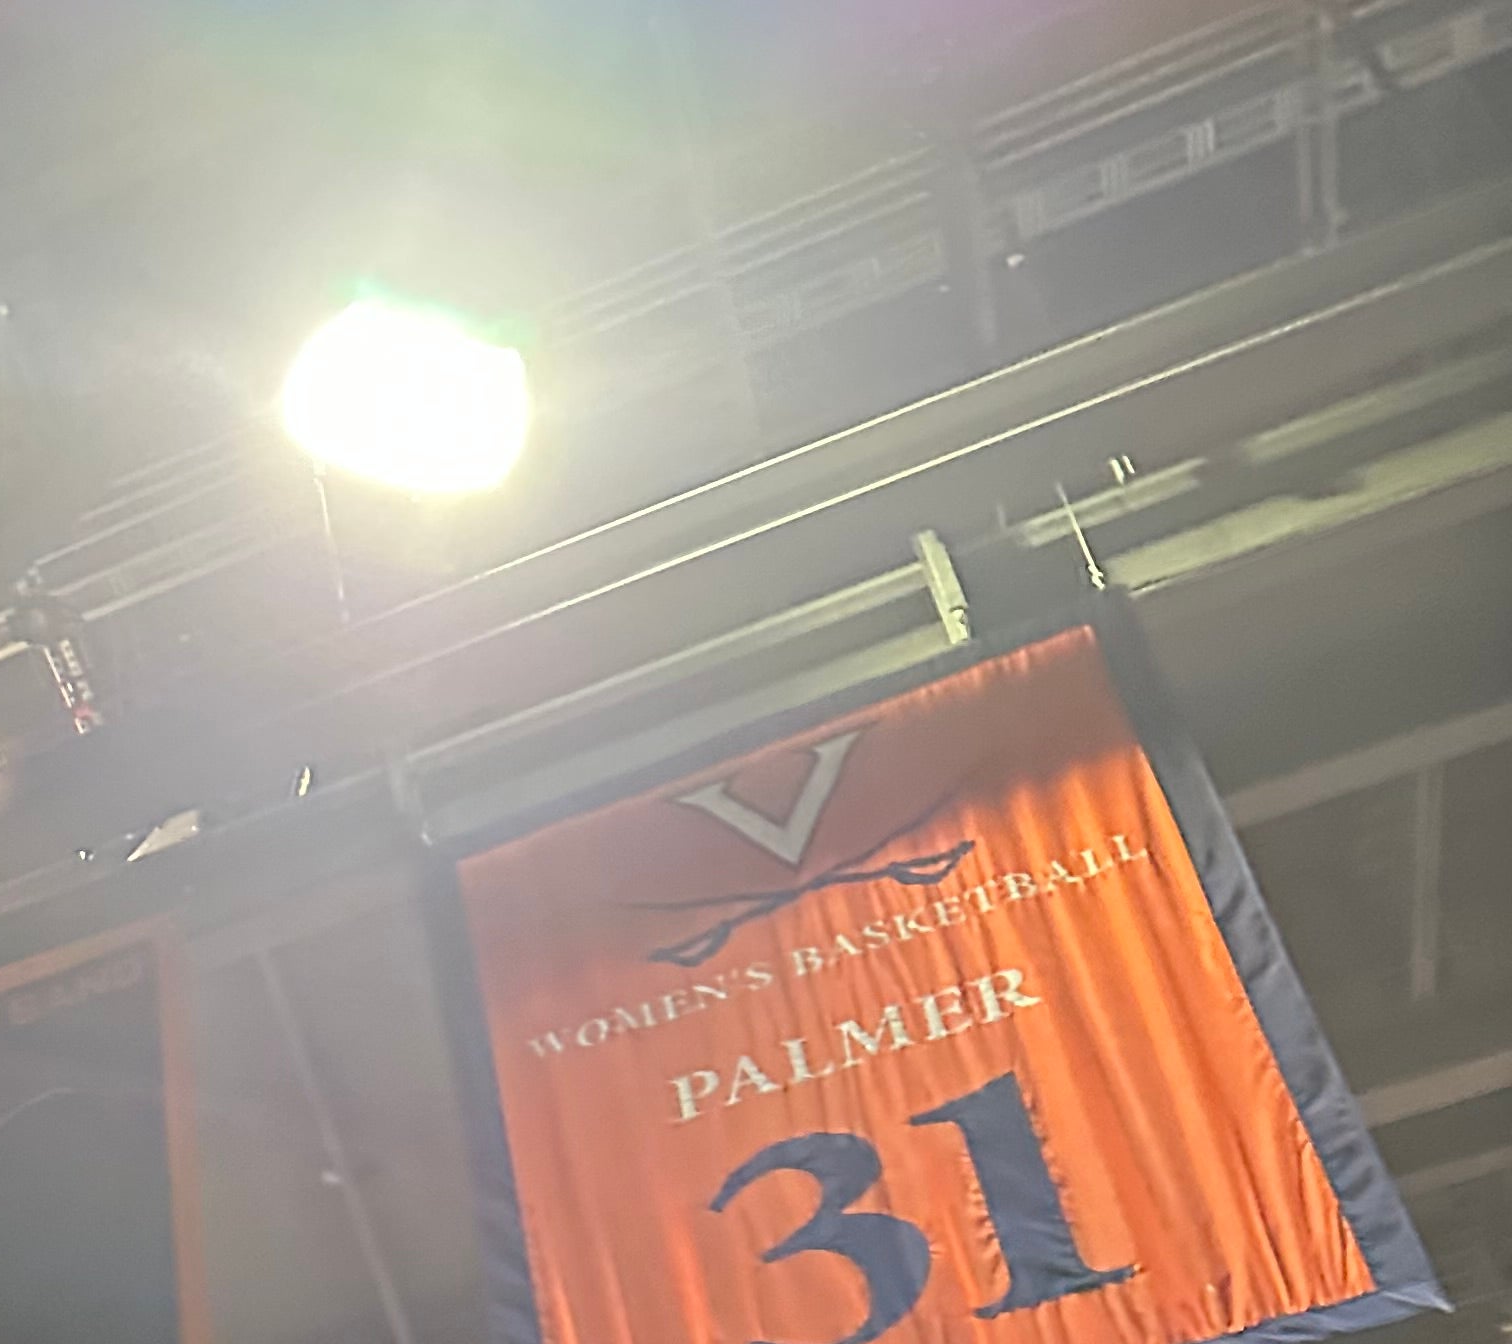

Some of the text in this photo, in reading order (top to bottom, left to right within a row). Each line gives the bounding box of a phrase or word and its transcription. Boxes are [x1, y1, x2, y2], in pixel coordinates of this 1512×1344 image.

[676, 726, 876, 868] V
[527, 834, 1149, 1061] WOMEN'S BASKETBALL
[672, 967, 1041, 1124] PALMER
